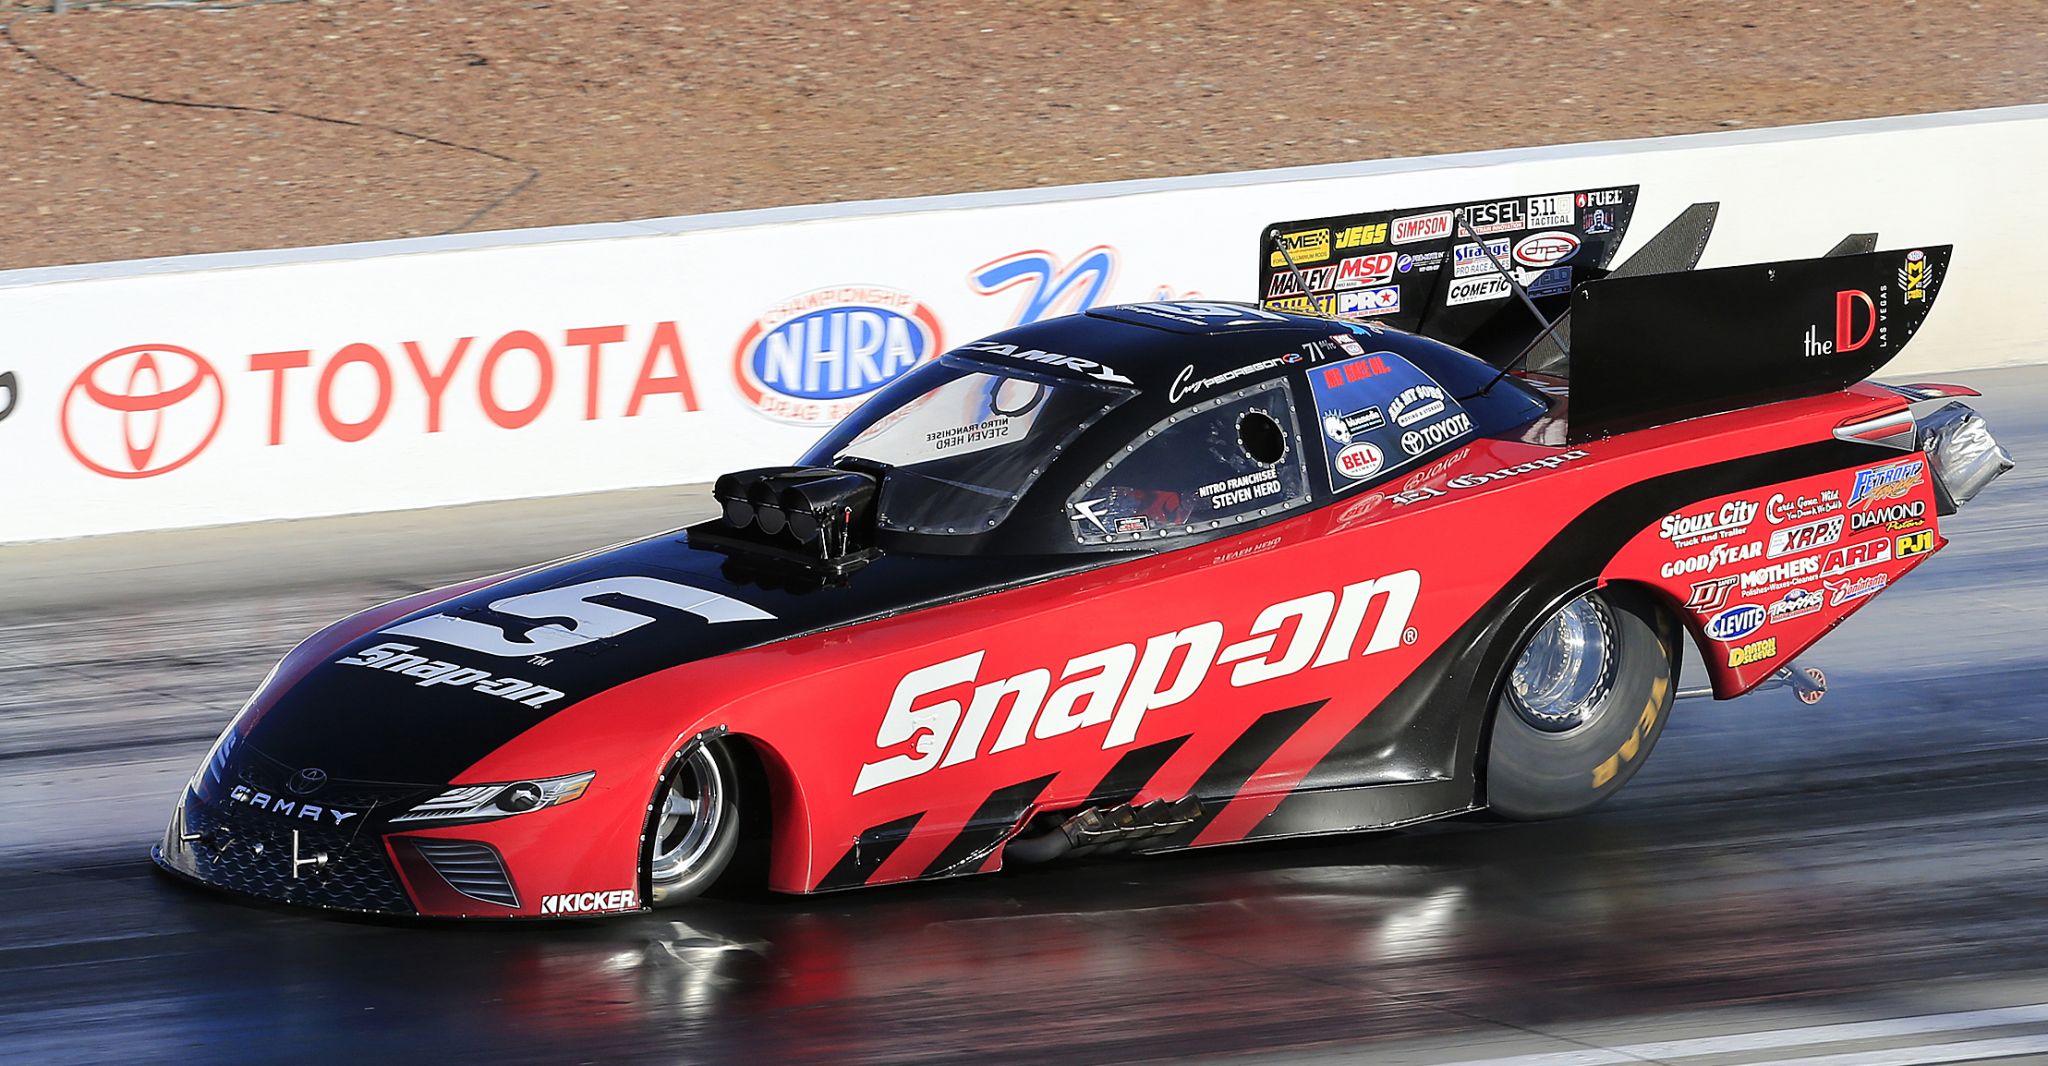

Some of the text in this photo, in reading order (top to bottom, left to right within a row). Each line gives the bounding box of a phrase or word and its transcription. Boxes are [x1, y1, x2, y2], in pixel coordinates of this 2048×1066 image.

[1531, 198, 1556, 217] 5.11
[1587, 189, 1622, 207] FUEL
[1396, 216, 1448, 239] SIMPSON
[1530, 214, 1570, 227] TACTICAL
[1335, 222, 1388, 249] JEGS
[1340, 255, 1393, 279] MSD
[1456, 265, 1469, 275] PRO
[1471, 264, 1488, 274] RACE
[1340, 288, 1397, 312] PRO
[1450, 276, 1509, 299] COMETIC
[1804, 290, 1876, 357] the D
[763, 310, 916, 393] NHRA
[956, 340, 1135, 385] CAMRY
[248, 320, 702, 446] TOYOTA
[1203, 357, 1285, 388] PEDREGON
[1420, 412, 1470, 446] TOYOTA
[1341, 449, 1377, 470] BELL
[1199, 469, 1277, 497] NITRO FRANCHISEE
[1212, 480, 1280, 509] STEVEN HERD
[1660, 500, 1760, 539] Sioux City
[1851, 501, 1925, 531] DIAMOND
[1885, 519, 1925, 532] Pistons
[1674, 527, 1747, 549] Truck And Trailer
[1782, 523, 1829, 552] XRP
[1898, 532, 1933, 557] PJ1
[1661, 541, 1763, 578] GOODYEAR
[1823, 539, 1890, 573] ARP
[1740, 557, 1820, 590] MOTHERS
[1706, 606, 1765, 638] CLEVITE
[335, 642, 566, 709] Snap-on
[853, 569, 1421, 796] Snap-on
[230, 785, 357, 825] CAMRY
[558, 890, 635, 913] KICKER
